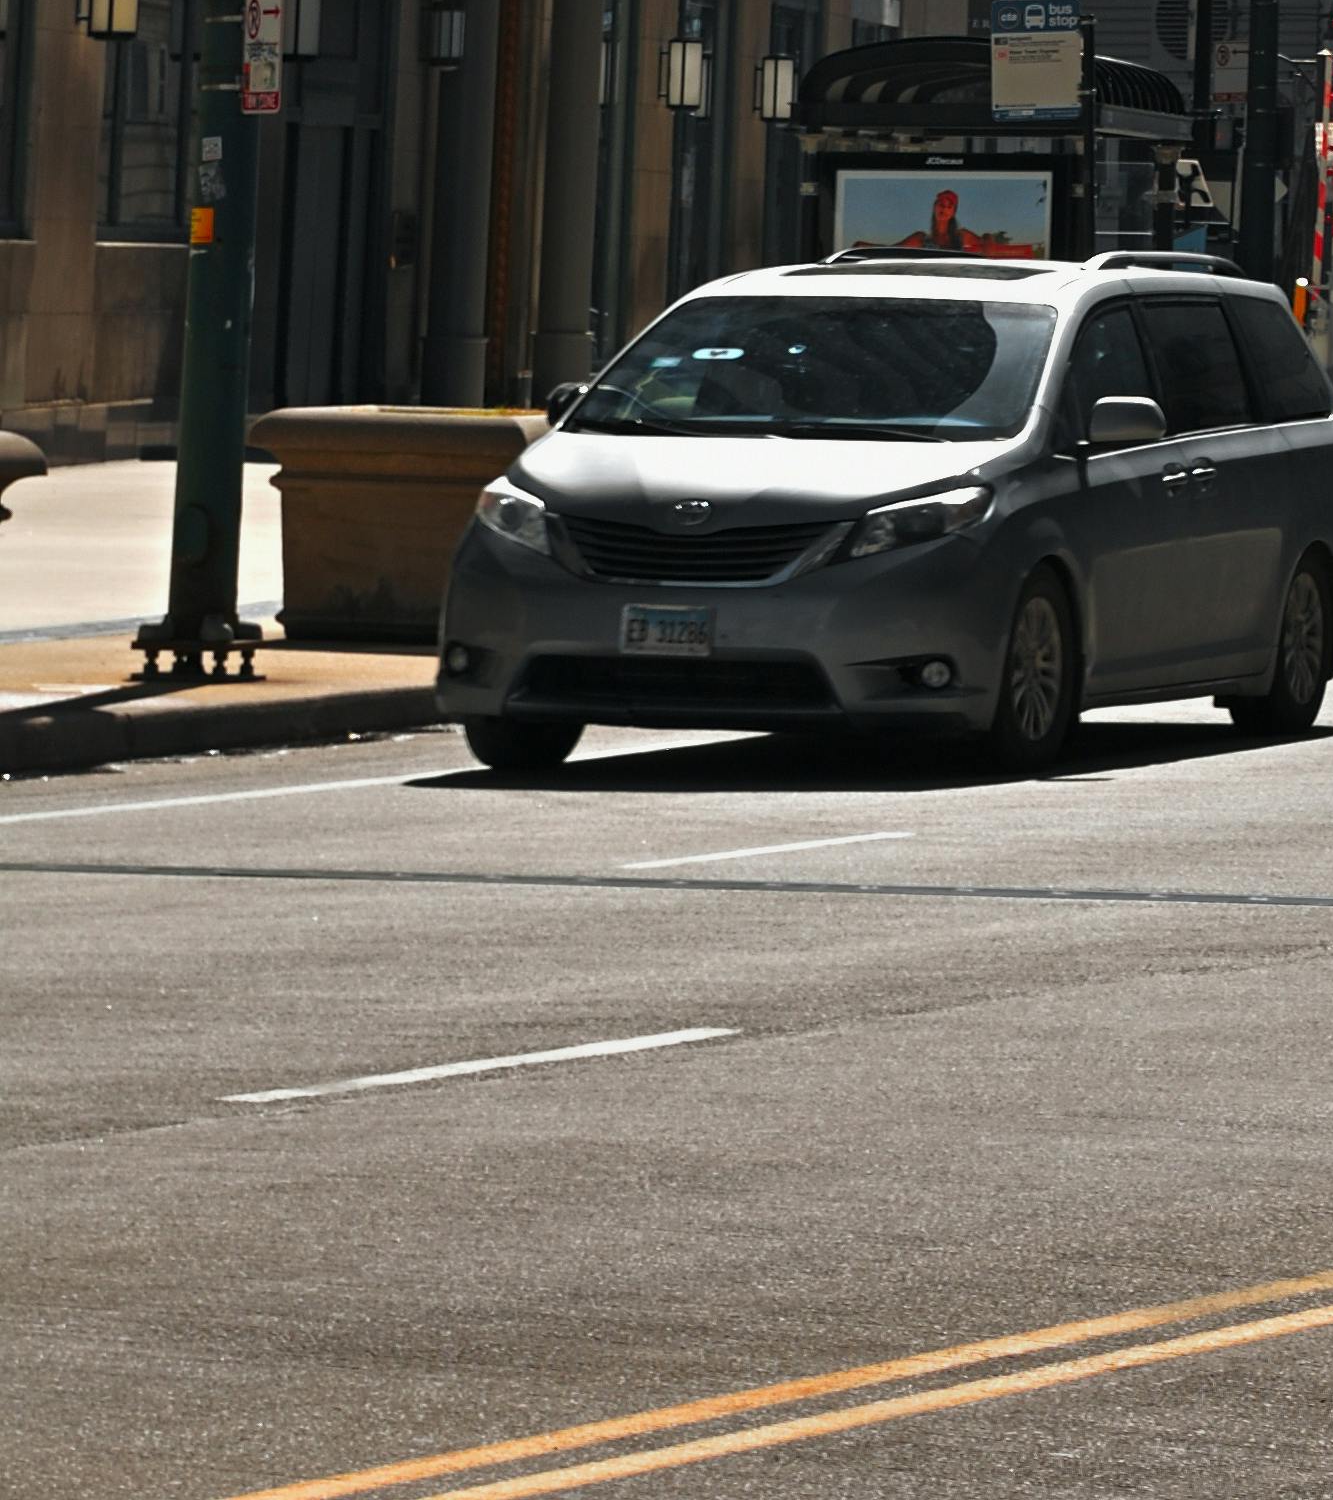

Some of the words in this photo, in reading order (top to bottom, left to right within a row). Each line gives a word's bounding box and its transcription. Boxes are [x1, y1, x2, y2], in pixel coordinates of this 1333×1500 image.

[1048, 3, 1072, 15] bus
[1000, 13, 1017, 22] cta
[1048, 15, 1079, 29] stop
